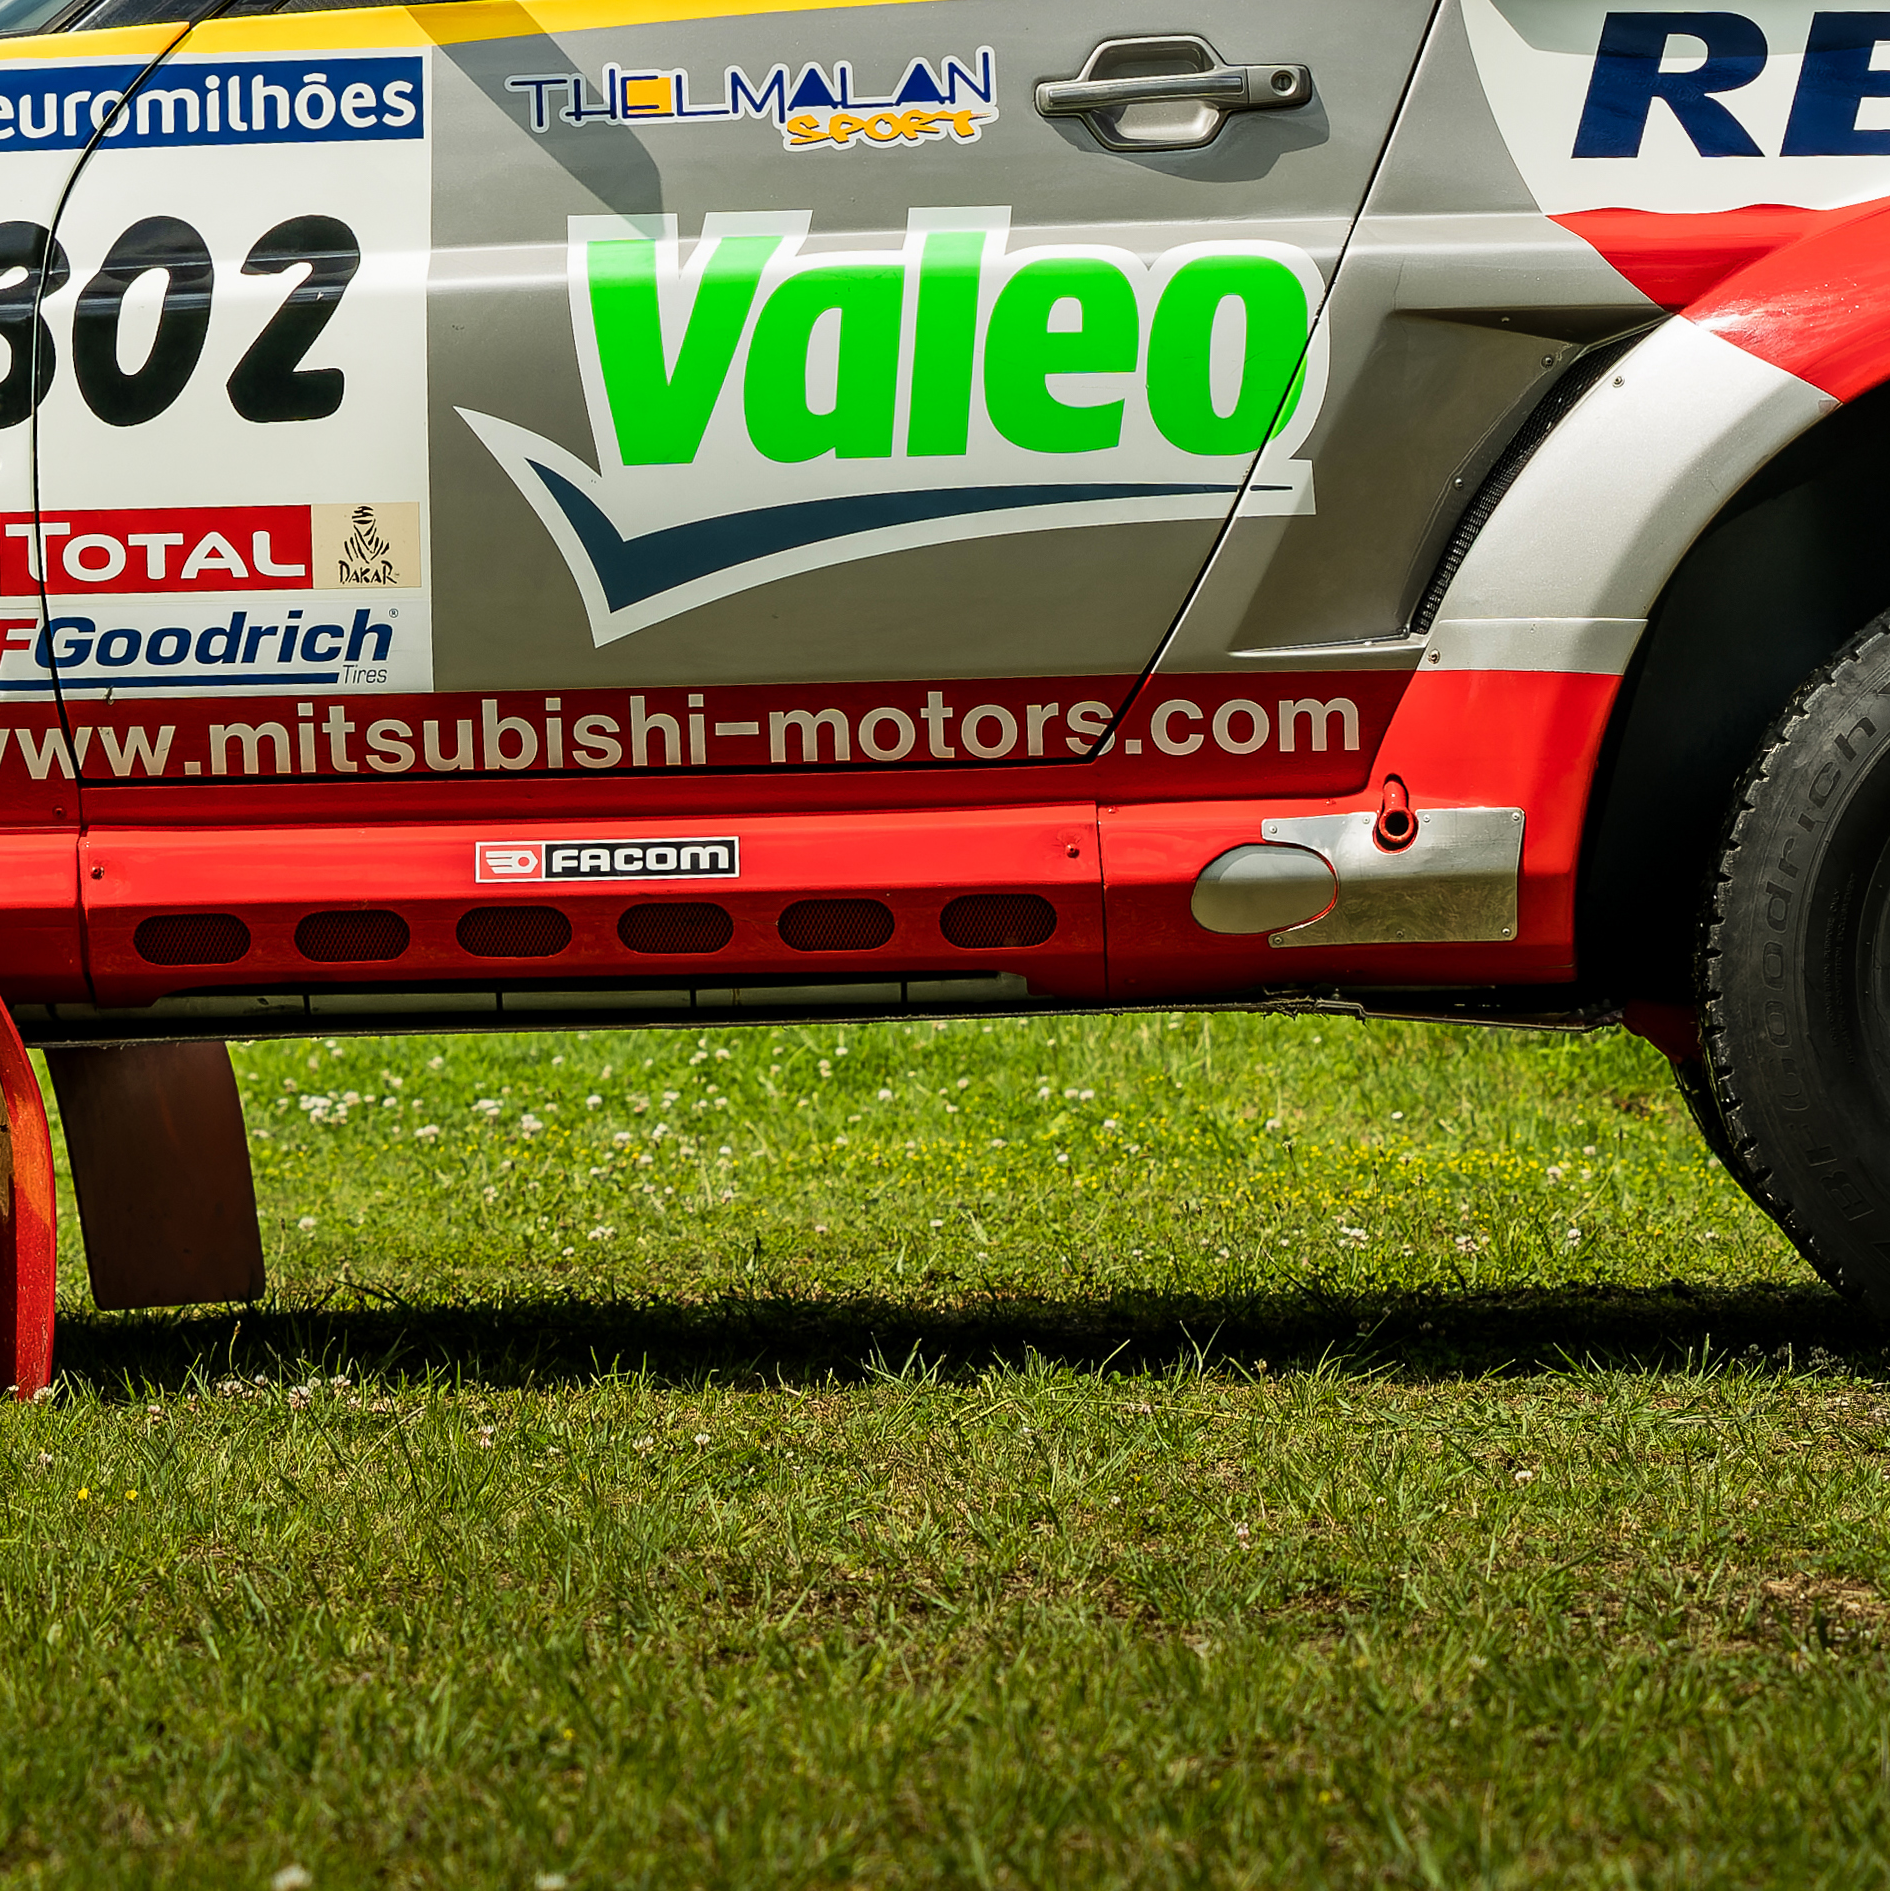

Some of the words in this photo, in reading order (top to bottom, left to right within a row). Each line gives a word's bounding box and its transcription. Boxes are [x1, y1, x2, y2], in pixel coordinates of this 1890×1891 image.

[509, 51, 991, 128] THELMALAN
[786, 108, 993, 146] SPORT
[586, 229, 1311, 467] Valeo
[5, 521, 306, 582] TOTAL
[338, 559, 396, 586] DAKAR
[341, 663, 388, 685] Tires
[551, 845, 730, 874] FACOM
[1761, 712, 1879, 1224] BFGoodrich
